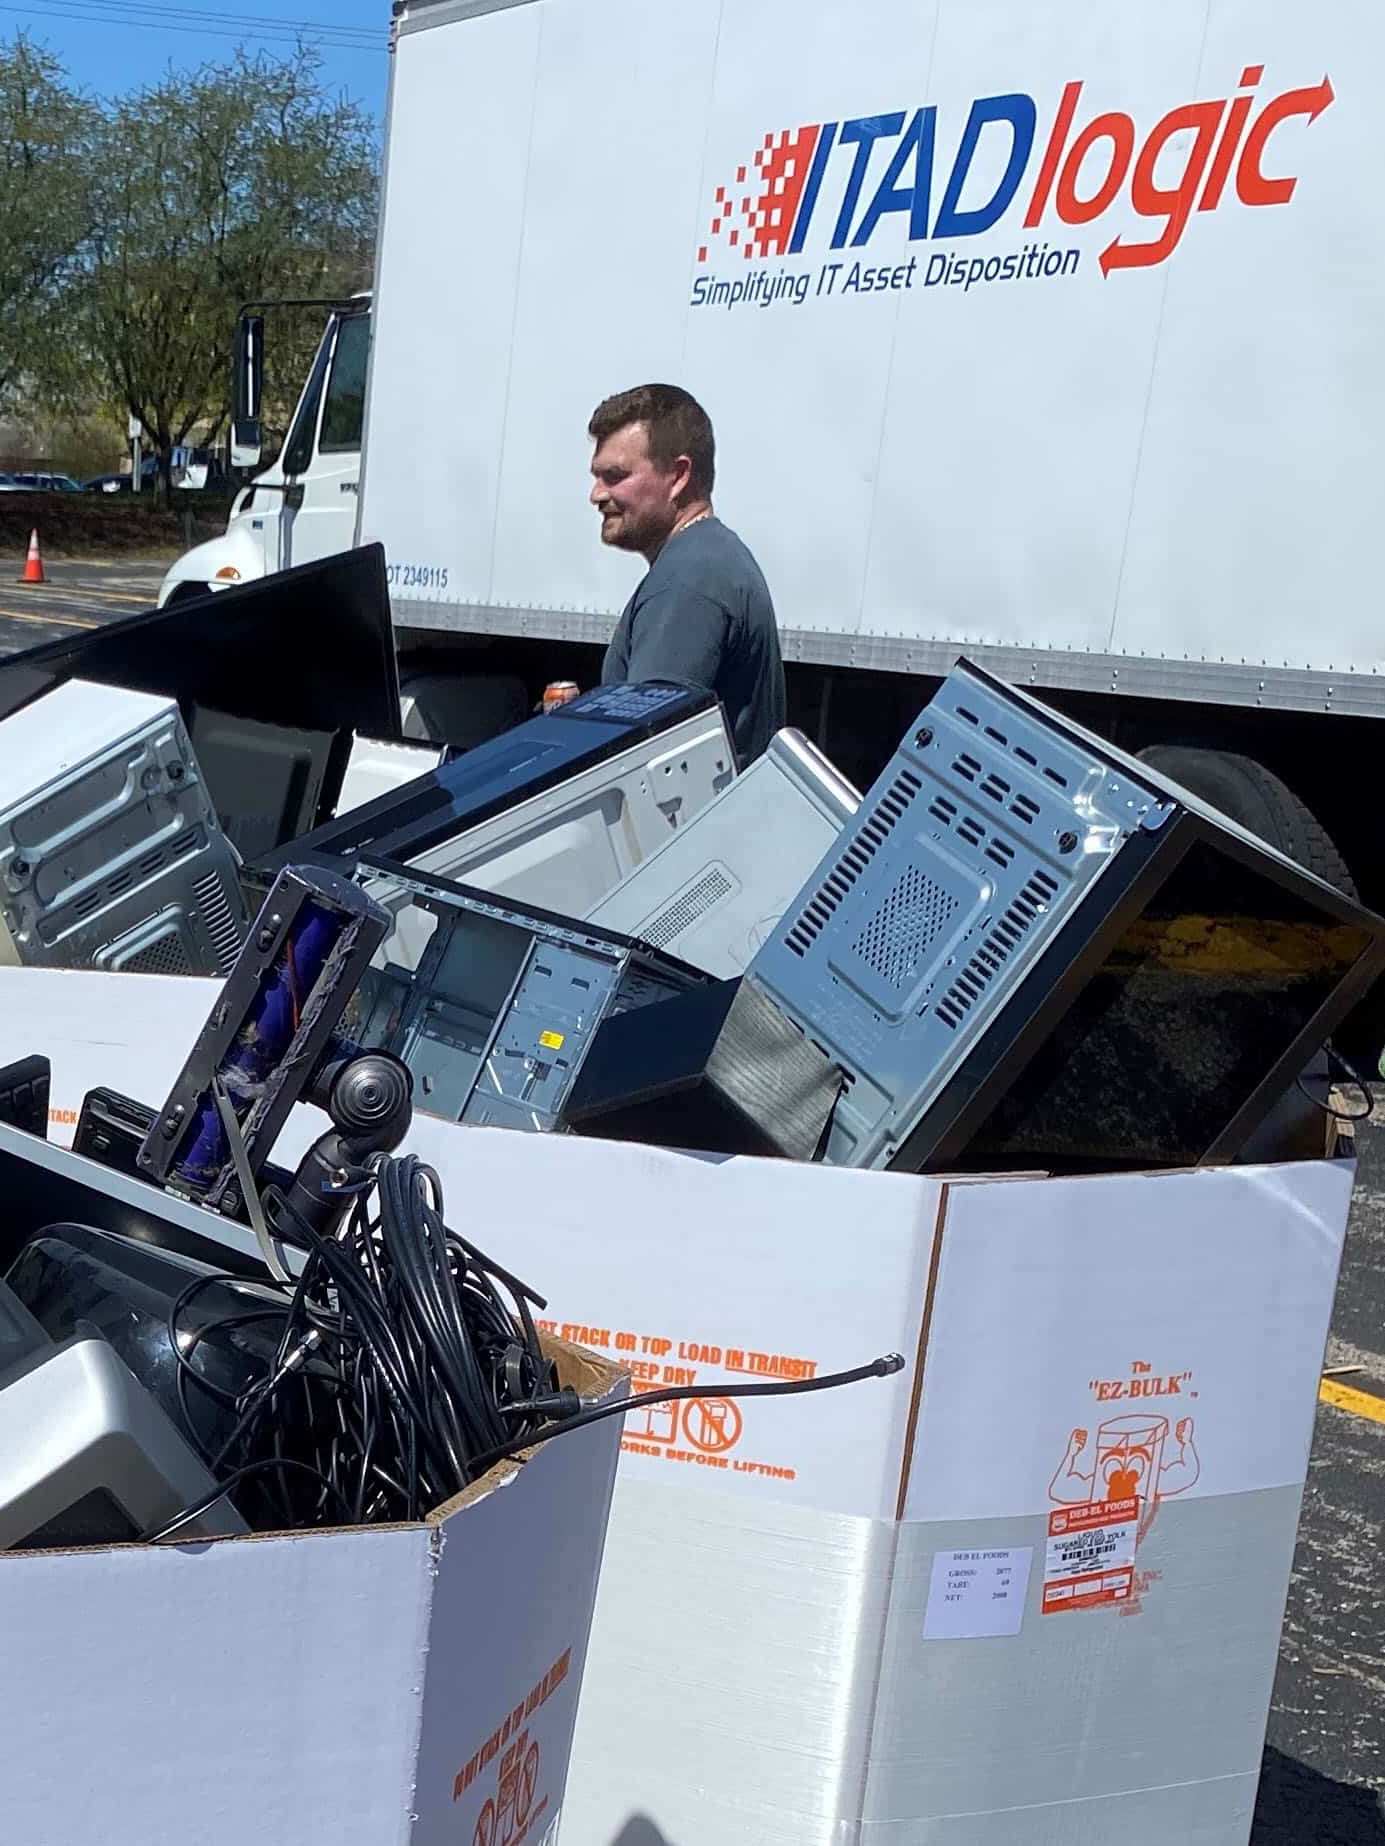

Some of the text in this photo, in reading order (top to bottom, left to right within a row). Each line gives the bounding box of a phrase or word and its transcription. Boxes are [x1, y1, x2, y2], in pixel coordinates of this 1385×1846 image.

[788, 64, 1335, 279] ITADlogic
[690, 243, 1080, 311] Simplifying IT Asset Disposition
[403, 566, 448, 588] 2349115
[48, 1109, 77, 1124] TACK
[535, 1319, 817, 1378] OT STACK OR TOP LOAD IN TRANSIT
[663, 1366, 696, 1386] DRY
[1131, 1360, 1151, 1374] The
[1089, 1371, 1192, 1401] "EZ-BULK"
[620, 1440, 796, 1481] ORKS BEFORE LIFTING
